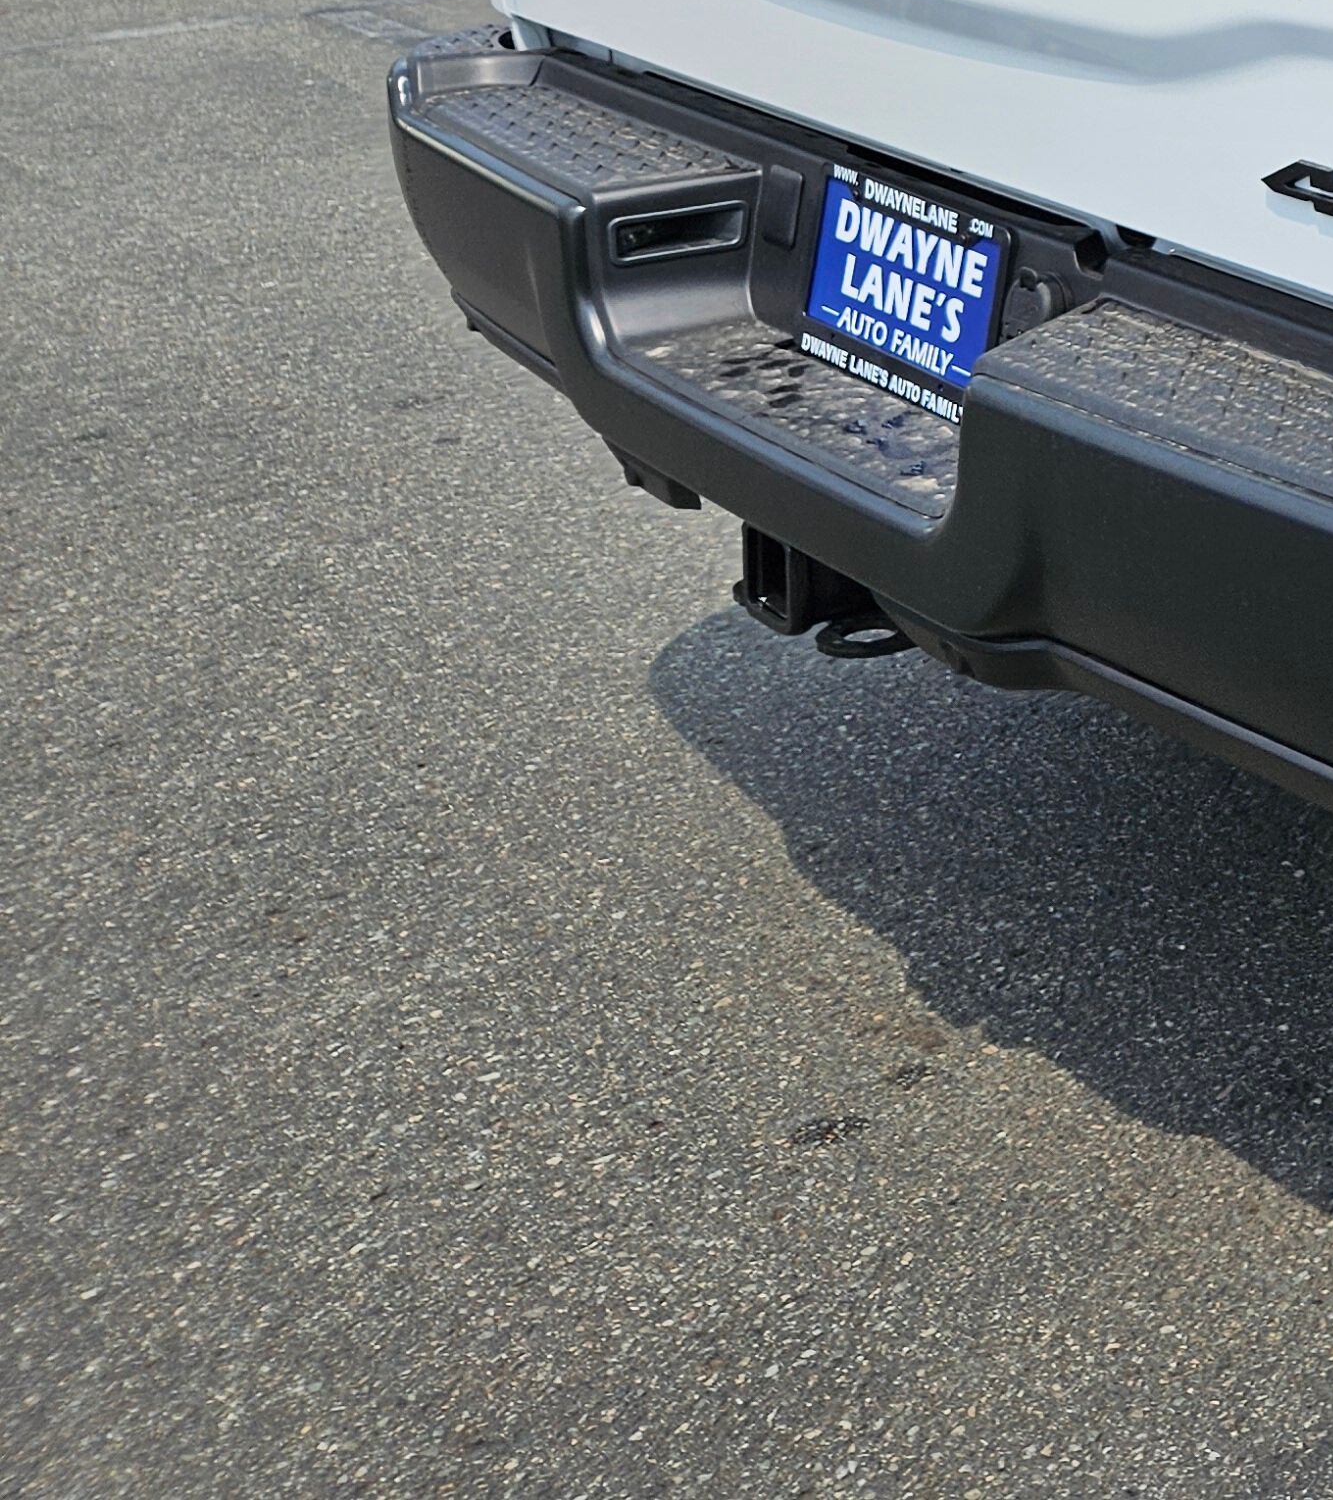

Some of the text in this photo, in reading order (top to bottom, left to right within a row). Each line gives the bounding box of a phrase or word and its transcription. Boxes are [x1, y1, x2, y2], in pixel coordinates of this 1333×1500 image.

[864, 179, 958, 233] DWAYNELANE
[835, 198, 988, 298] DWAYNE
[840, 253, 965, 343] LANE'S
[801, 331, 848, 369] DWAYNE
[848, 353, 889, 388] LANE'S
[888, 373, 921, 403] AUTO
[836, 305, 954, 376] AUTO FAMILY
